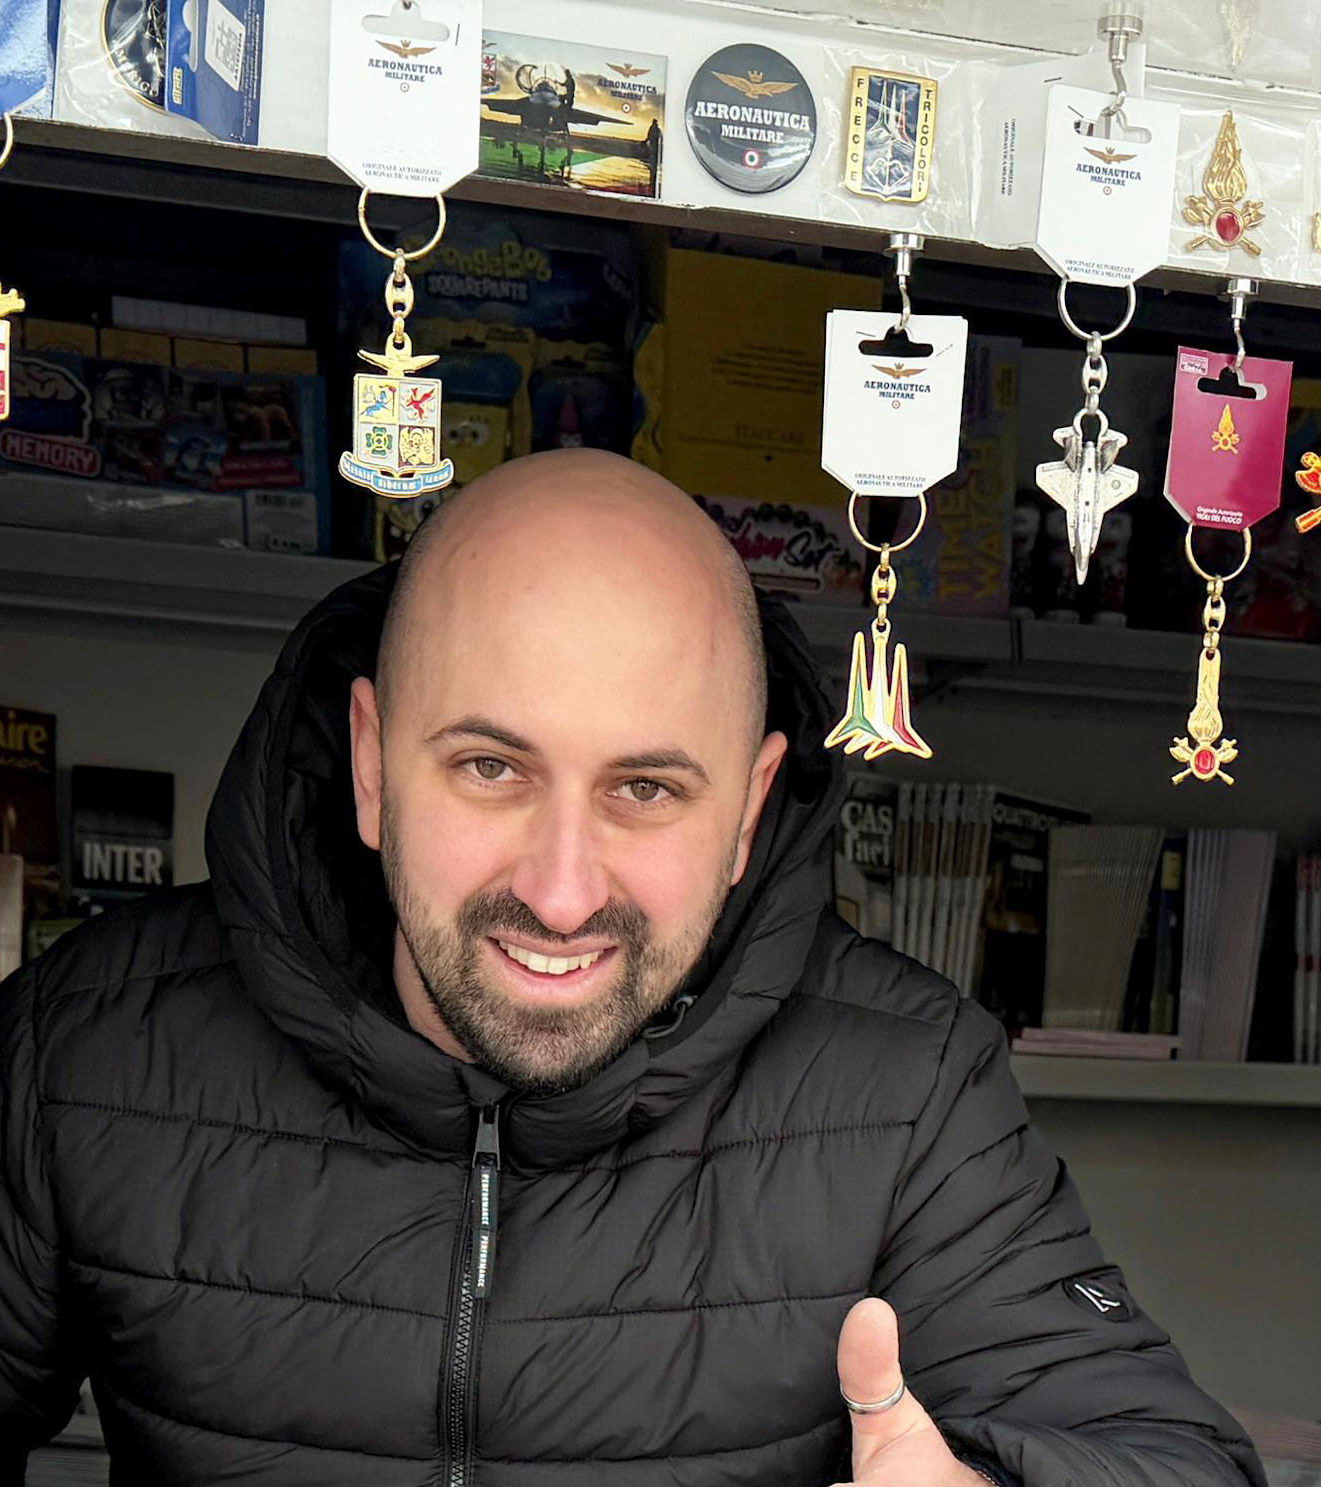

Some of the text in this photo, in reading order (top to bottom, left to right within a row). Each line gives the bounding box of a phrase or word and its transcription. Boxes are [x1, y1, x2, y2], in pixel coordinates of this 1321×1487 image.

[368, 59, 442, 76] AERONAUTICA
[385, 72, 425, 82] MILITARE
[695, 101, 810, 130] AERONAUTICA
[721, 123, 784, 144] MILITARE
[850, 78, 864, 182] FRECCE
[917, 89, 932, 192] TRICOLORI
[1076, 163, 1141, 180] AERONAUTICA
[1090, 175, 1126, 186] MILITARE
[864, 380, 931, 393] AERONAUTICA
[879, 391, 915, 400] MILITARE
[2, 432, 99, 474] MEMORY
[83, 842, 164, 886] INTER
